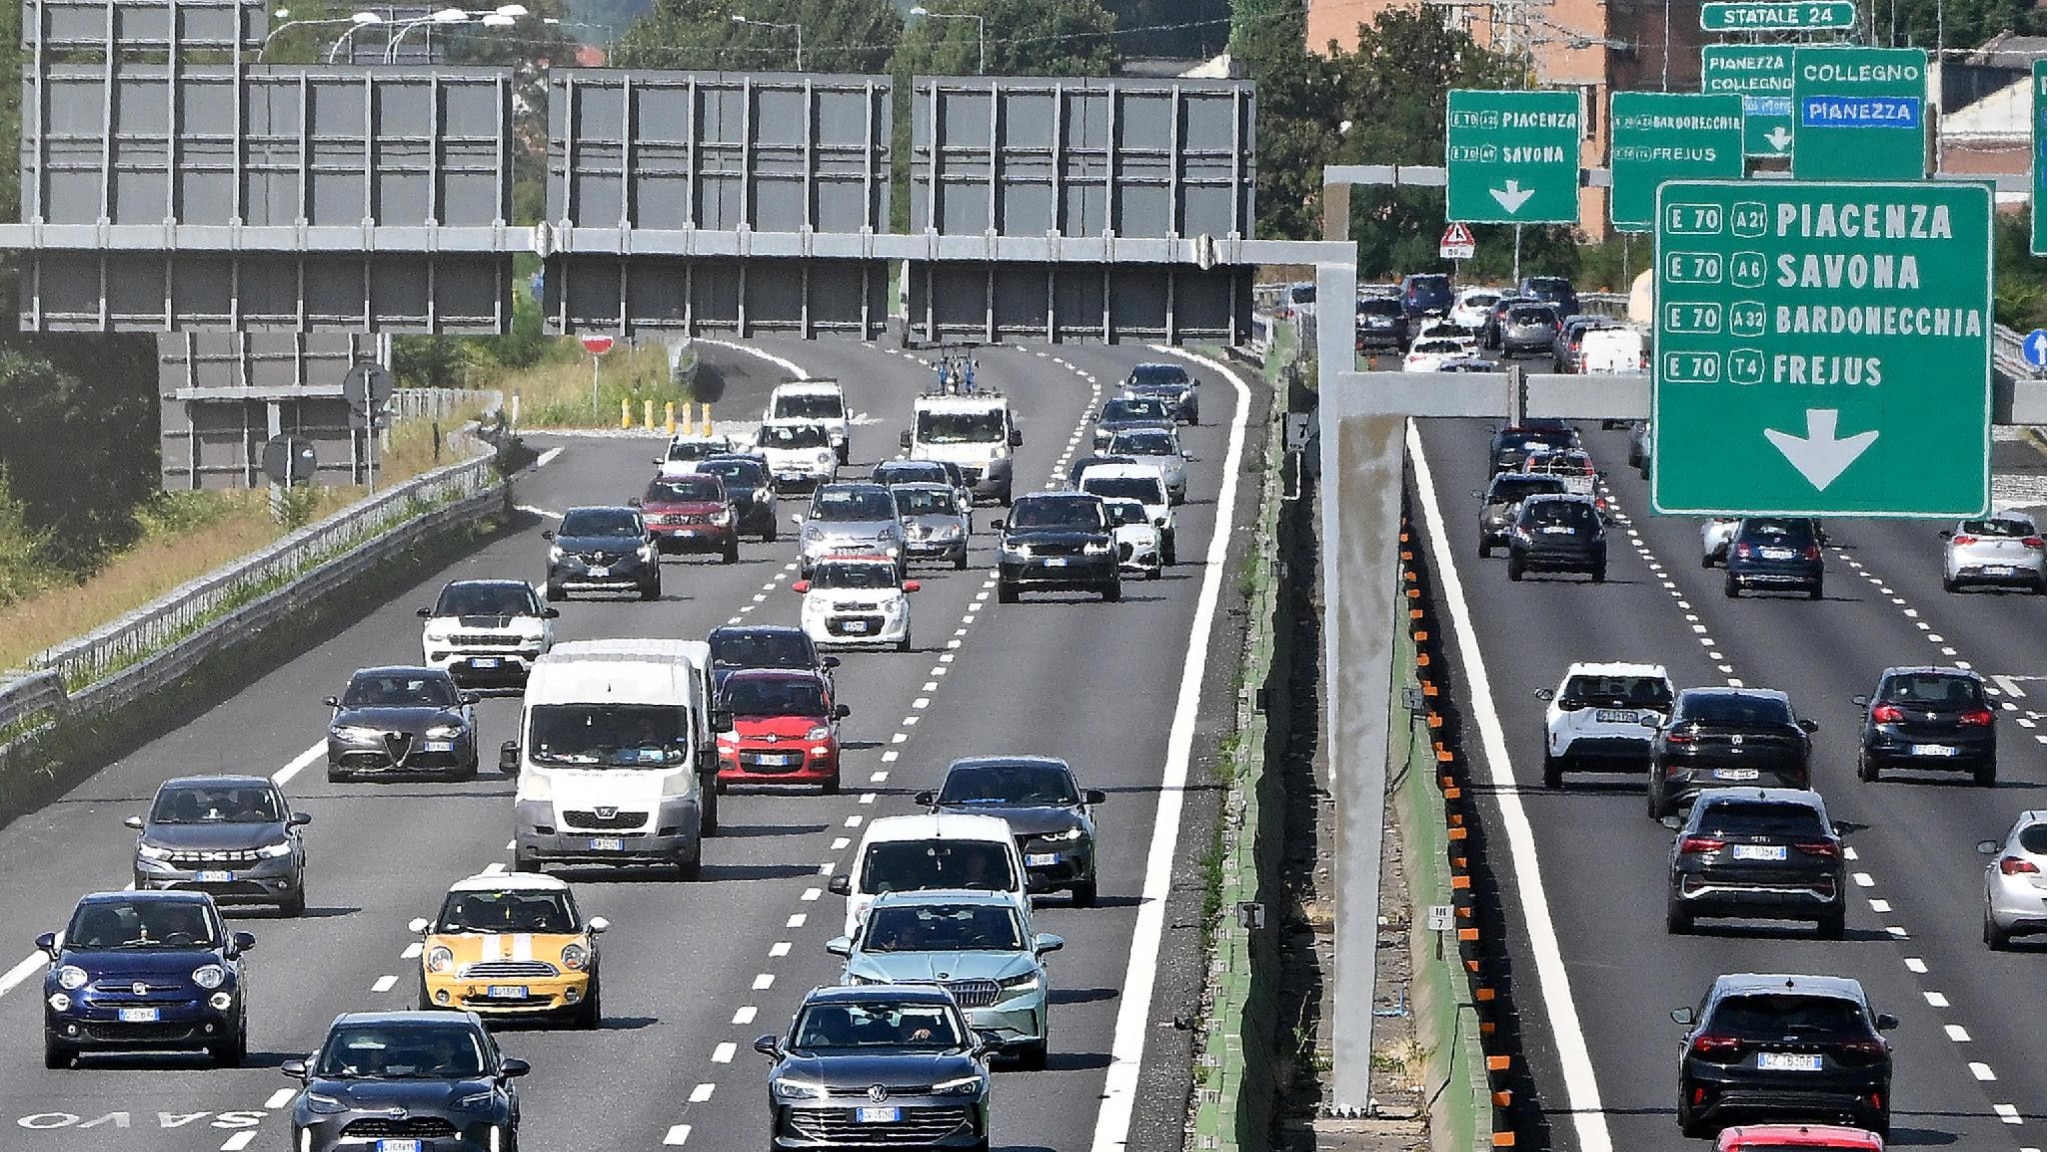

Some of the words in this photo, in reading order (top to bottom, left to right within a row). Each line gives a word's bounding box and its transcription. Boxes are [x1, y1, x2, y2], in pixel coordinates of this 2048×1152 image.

[1724, 8, 1799, 24] STATALE
[1808, 8, 1833, 23] 24
[1709, 55, 1785, 71] PIANEZZA
[1803, 64, 1919, 82] COLLEGNO
[1711, 77, 1792, 91] COLLEGNO
[1809, 103, 1911, 120] PIANEZZA
[1503, 112, 1576, 129] PIACENZA
[1653, 116, 1741, 130] BARDONECCHIA
[1503, 146, 1564, 163] SAVONA
[1653, 147, 1717, 161] FREJUS
[1671, 209, 1683, 229] E
[1694, 209, 1719, 229] 70
[1776, 203, 1952, 239] PIACENZA
[1671, 257, 1683, 277] E
[1694, 257, 1719, 278] 70
[1776, 253, 1920, 289] SAVONA
[1670, 307, 1682, 328] E
[1693, 307, 1718, 328] 70
[1776, 305, 1981, 337] BARDONECCHIA
[1669, 356, 1681, 377] E
[1691, 356, 1716, 377] 70
[1773, 354, 1882, 387] FREJUS
[1437, 919, 1444, 929] 7
